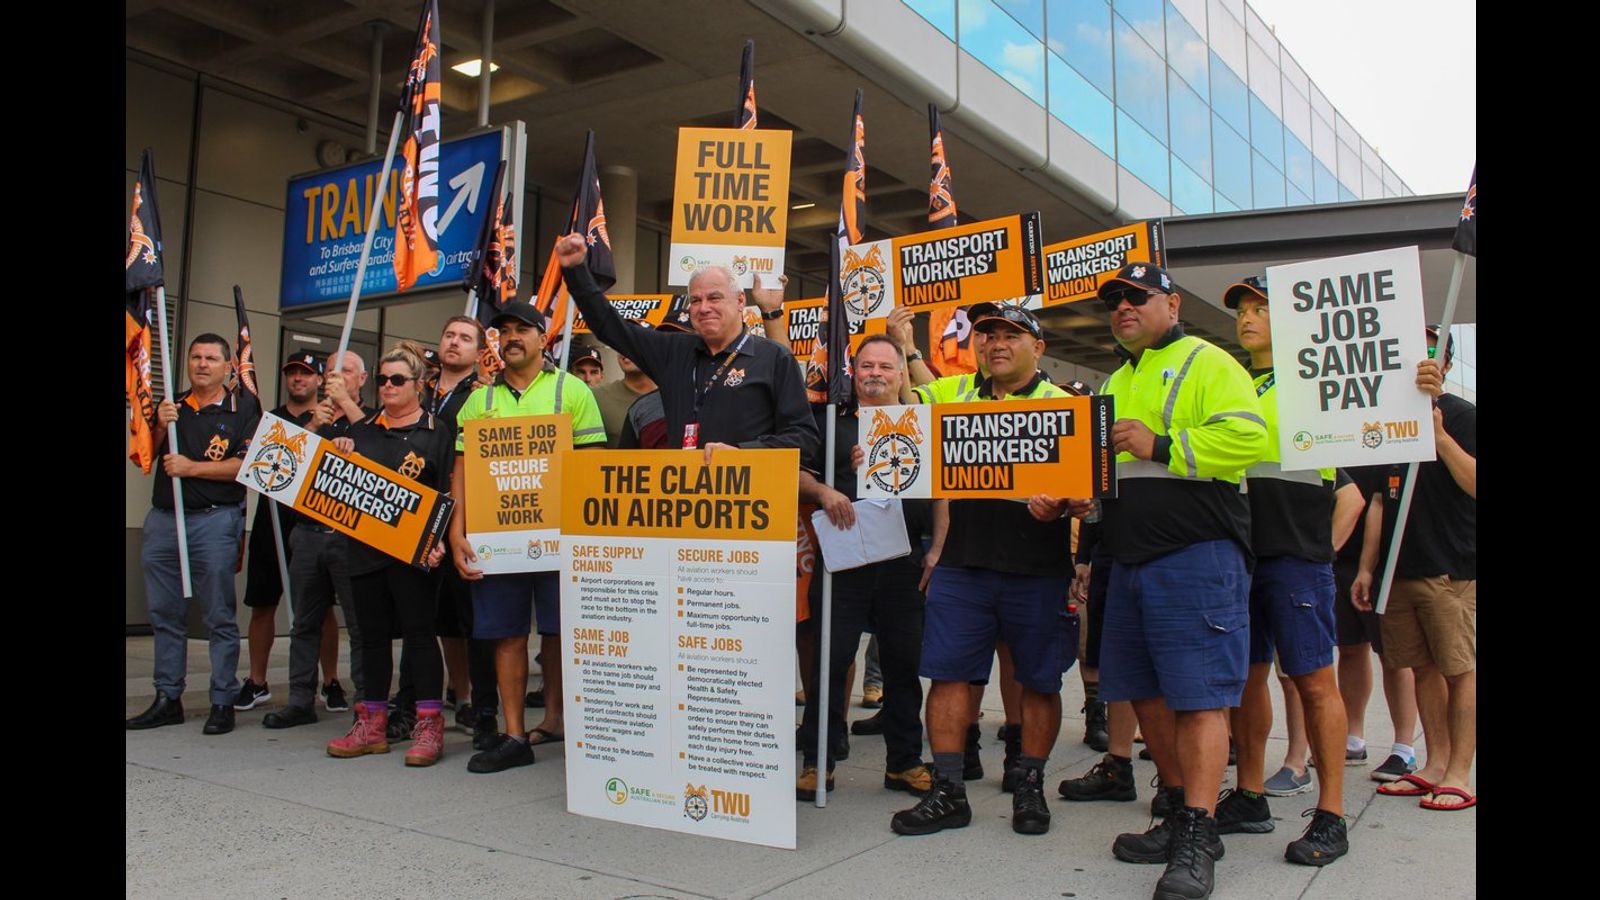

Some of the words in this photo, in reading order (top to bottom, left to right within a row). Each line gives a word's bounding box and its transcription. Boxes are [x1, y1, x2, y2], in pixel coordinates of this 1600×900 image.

[698, 140, 770, 170] FULL
[694, 172, 770, 201] TIME
[683, 204, 777, 234] WORK
[320, 246, 331, 259] To
[374, 236, 394, 250] City
[901, 228, 1005, 264] TRANSPORT
[1047, 234, 1134, 266] TRANSPORT
[309, 261, 328, 276] and
[328, 257, 360, 273] Surfers
[750, 257, 774, 271] TWU
[903, 253, 994, 286] WORKERS'
[1048, 254, 1125, 284] WORKERS'
[904, 282, 958, 305] UNION
[1050, 278, 1095, 300] UNION
[1292, 269, 1396, 313] SAME
[1311, 307, 1381, 344] JOB
[1297, 338, 1402, 380] SAME
[1318, 375, 1384, 412] PAY
[478, 426, 522, 442] SAME
[527, 424, 557, 440] JOB
[942, 411, 1072, 439] TRANSPORT
[1384, 420, 1419, 439] TWU
[480, 442, 524, 458] SAME
[528, 440, 556, 455] PAY
[943, 437, 1056, 464] WORKERS'
[489, 458, 549, 476] SECURE
[322, 452, 420, 511] TRANSPORT
[495, 475, 543, 491] WORK
[600, 465, 650, 493] THE
[660, 465, 750, 494] CLAIM
[944, 465, 1009, 490] UNION
[314, 472, 401, 522] WORKERS'
[500, 493, 539, 509] SAFE
[306, 490, 358, 528] UNION
[496, 509, 544, 526] WORK
[583, 497, 618, 526] ON
[626, 498, 768, 529] AIRPORTS
[572, 544, 599, 557] SAFE
[602, 546, 643, 559] SUPPLY
[677, 548, 723, 562] SECURE
[726, 550, 758, 563] JOBS
[572, 559, 612, 572] CHAINS
[580, 576, 602, 584] Airport
[686, 587, 712, 596] Regular
[714, 588, 735, 596] hours.
[686, 599, 723, 608] Permanent
[606, 614, 633, 623] industry.
[686, 610, 719, 619] Maximum
[720, 614, 760, 623] opportunity
[686, 620, 714, 629] full-time
[573, 627, 604, 641] SAME
[607, 630, 629, 643] JOB
[678, 635, 707, 649] SAFE
[710, 637, 742, 652] JOBS
[574, 641, 604, 655] SAME
[608, 644, 627, 657] PAY
[632, 672, 653, 680] should
[697, 667, 737, 676] represented
[686, 674, 735, 686] democratically
[736, 679, 762, 688] elected
[582, 686, 616, 695] conditions.
[687, 684, 708, 692] Health
[716, 686, 737, 696] Safety
[687, 693, 742, 705] Representatives.
[687, 704, 713, 714] Receive
[738, 710, 765, 720] training
[687, 724, 707, 733] safely
[753, 730, 775, 739] duties
[739, 720, 754, 728] they
[705, 744, 717, 753] day
[718, 746, 737, 755] injury
[738, 747, 754, 756] free.
[722, 736, 742, 745] home
[743, 739, 760, 747] from
[688, 753, 704, 761] Have
[711, 757, 744, 767] collective
[697, 764, 722, 773] treated
[738, 770, 767, 778] respect.
[630, 786, 650, 796] SAFE
[710, 789, 749, 816] TWU
